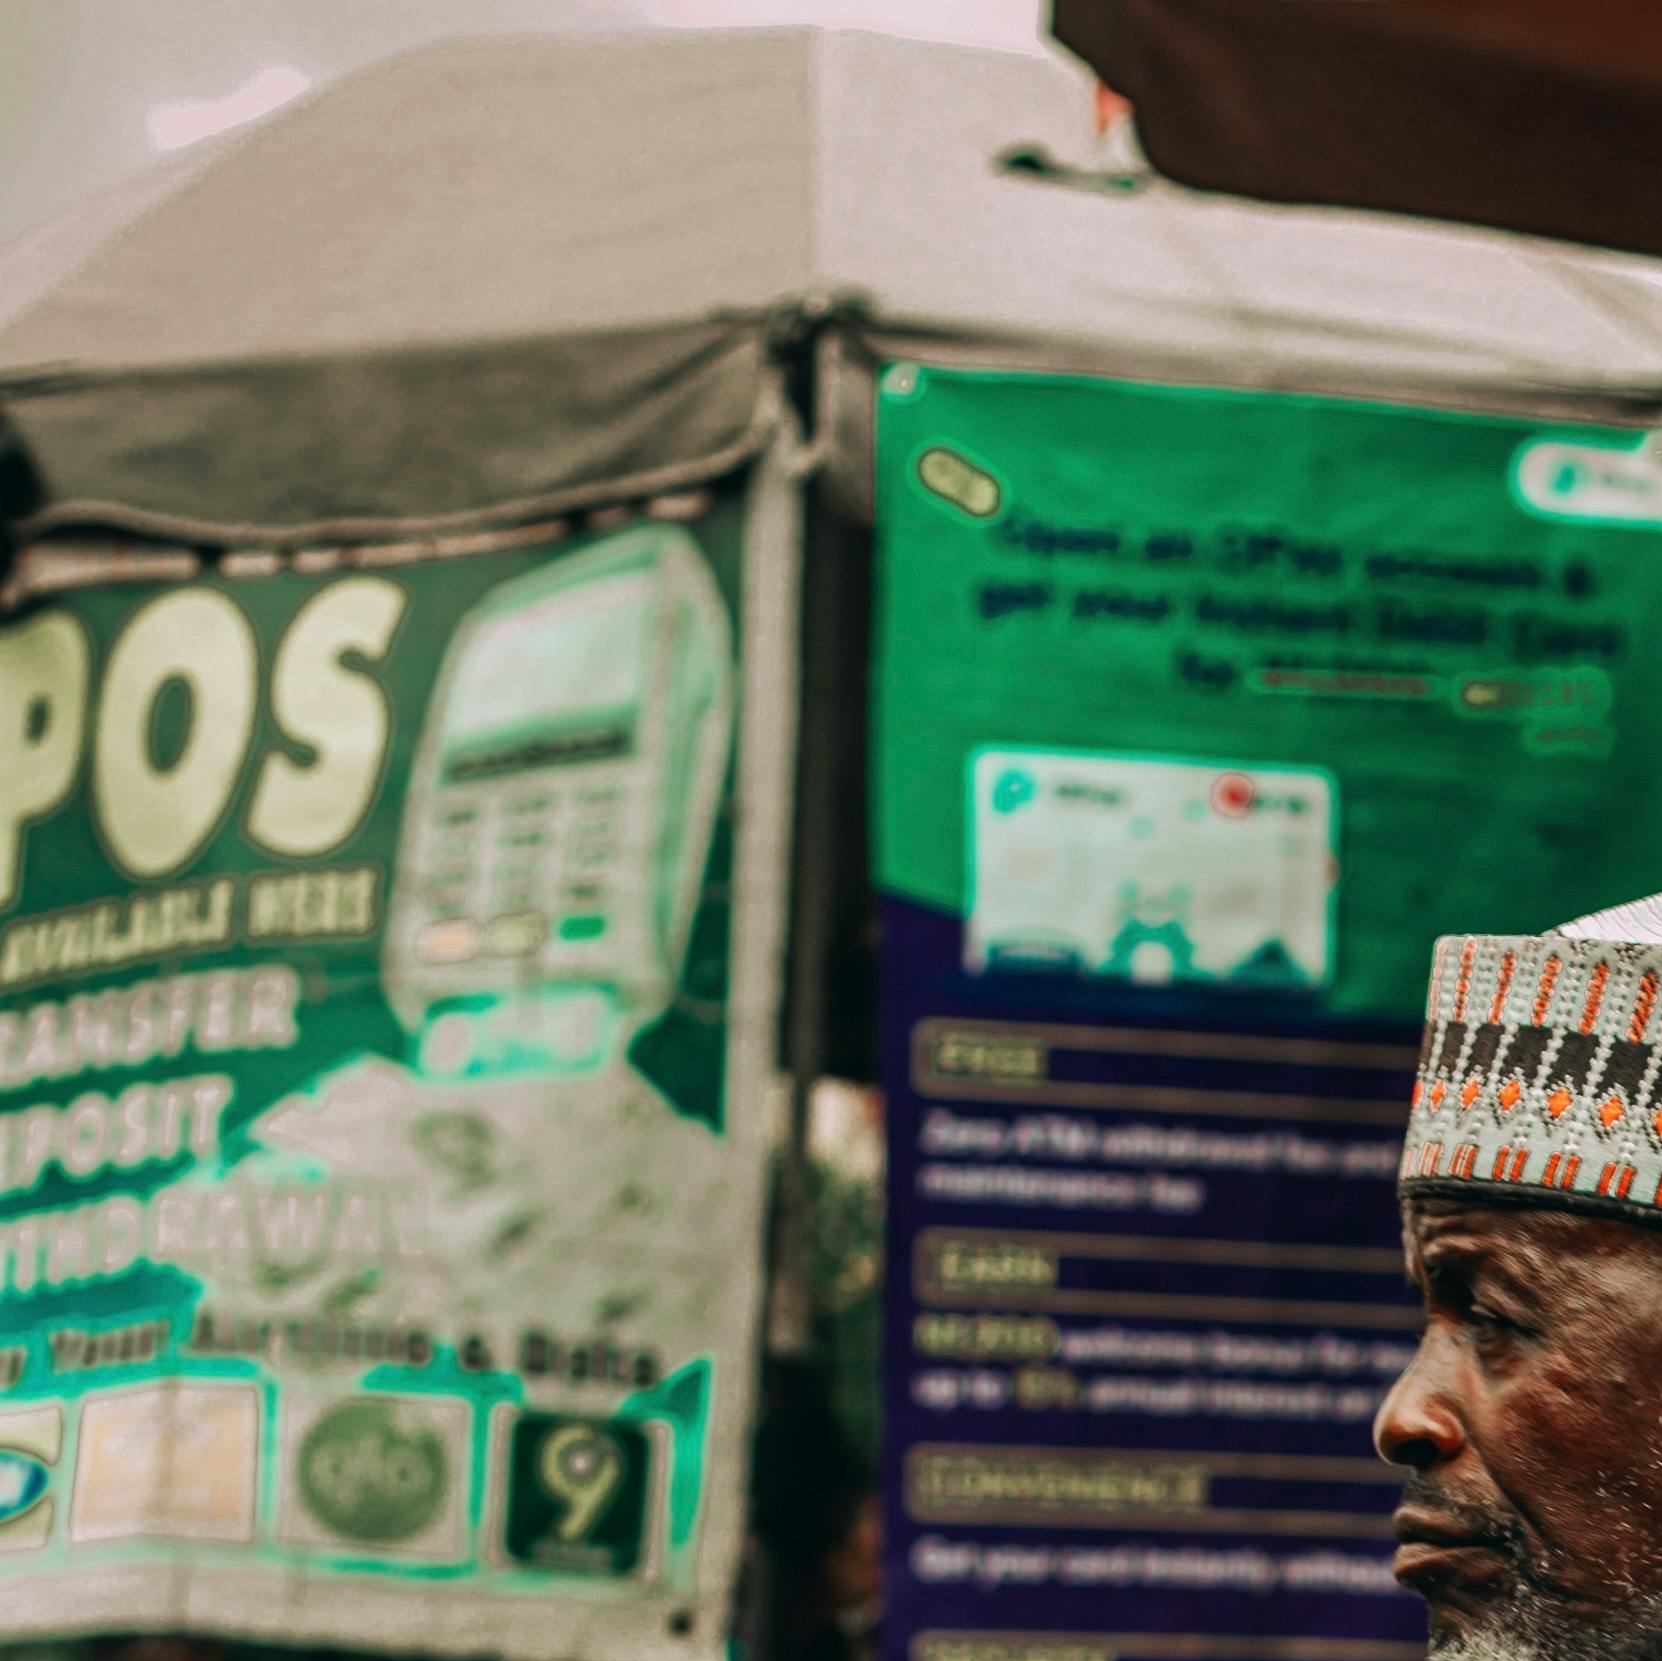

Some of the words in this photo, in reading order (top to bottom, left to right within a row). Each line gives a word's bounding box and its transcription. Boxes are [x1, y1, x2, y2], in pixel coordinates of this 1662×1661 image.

[0, 576, 409, 908] POS
[1, 879, 235, 985] AVAILABLE
[248, 869, 376, 938] HERE
